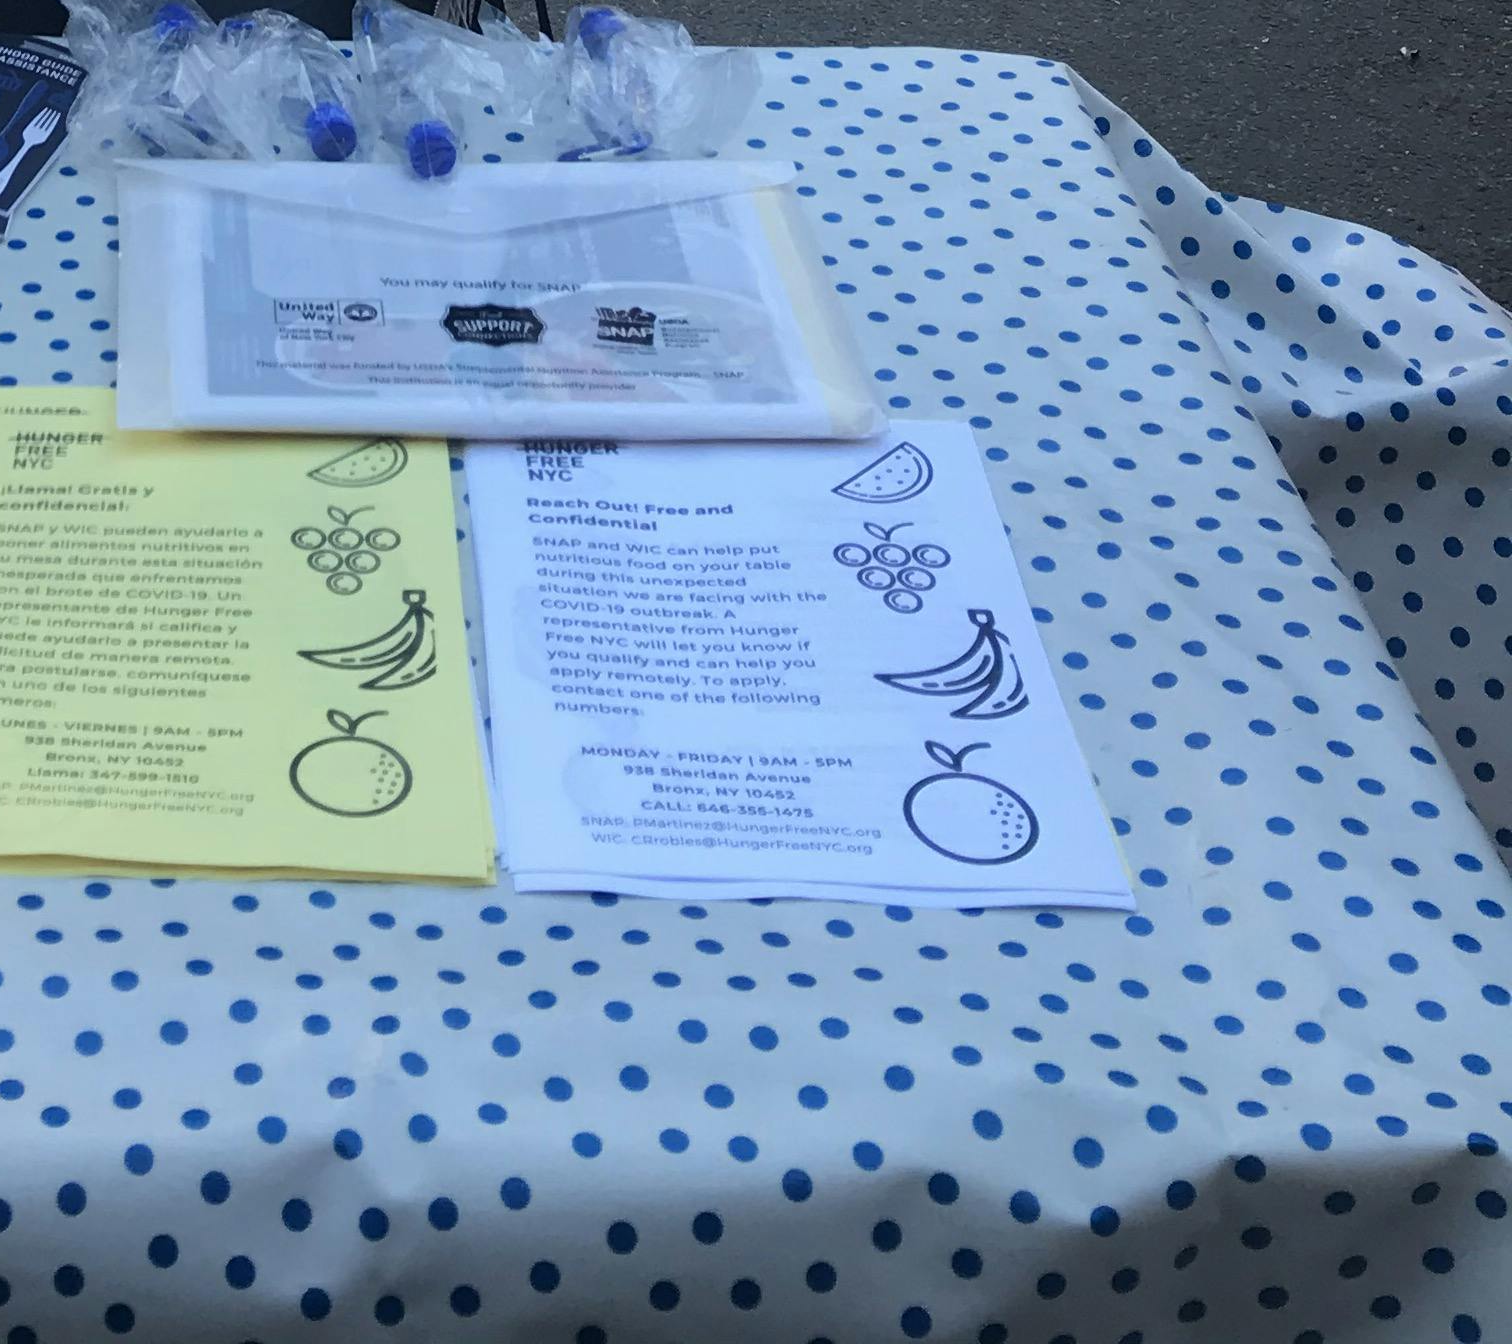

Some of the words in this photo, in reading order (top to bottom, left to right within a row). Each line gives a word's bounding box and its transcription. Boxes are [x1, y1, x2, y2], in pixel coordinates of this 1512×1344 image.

[42, 59, 83, 78] GUIDE
[380, 276, 411, 290] You
[415, 279, 449, 291] may
[453, 278, 507, 293] qualify
[511, 279, 534, 291] for
[278, 301, 335, 312] United
[302, 312, 335, 322] Way
[454, 319, 533, 334] SUPPORT
[598, 326, 655, 338] SNAP
[15, 431, 104, 445] HUNGER
[14, 444, 69, 457] FREE
[523, 440, 620, 455] HUNGER
[13, 458, 54, 470] NYC
[527, 456, 585, 469] FREE
[528, 469, 574, 482] NYC
[78, 484, 138, 495] Gratis
[527, 497, 589, 510] Reach
[596, 499, 638, 513] Out!
[645, 504, 690, 515] Free
[695, 504, 734, 515] and
[528, 513, 657, 532] Confidential
[532, 536, 582, 548] SNAP
[588, 540, 620, 551] and
[626, 543, 662, 554] WIC
[666, 546, 698, 556] can
[704, 544, 743, 557] help
[750, 544, 781, 556] put
[534, 552, 622, 567] nutritious
[627, 558, 667, 571] food
[672, 562, 695, 571] on
[700, 561, 740, 574] your
[745, 560, 792, 570] table
[537, 567, 596, 583] during
[602, 571, 634, 584] this
[640, 576, 747, 590] unexpected
[539, 582, 619, 598] situation
[624, 590, 651, 600] we
[656, 592, 684, 602] are
[689, 592, 745, 605] facing
[751, 591, 792, 602] with
[797, 591, 827, 602] the
[580, 746, 660, 760] MONDAY
[678, 752, 743, 765] FRIDAY
[660, 766, 740, 781] Sheridan
[745, 772, 812, 784] Avenue
[716, 786, 740, 796] NY
